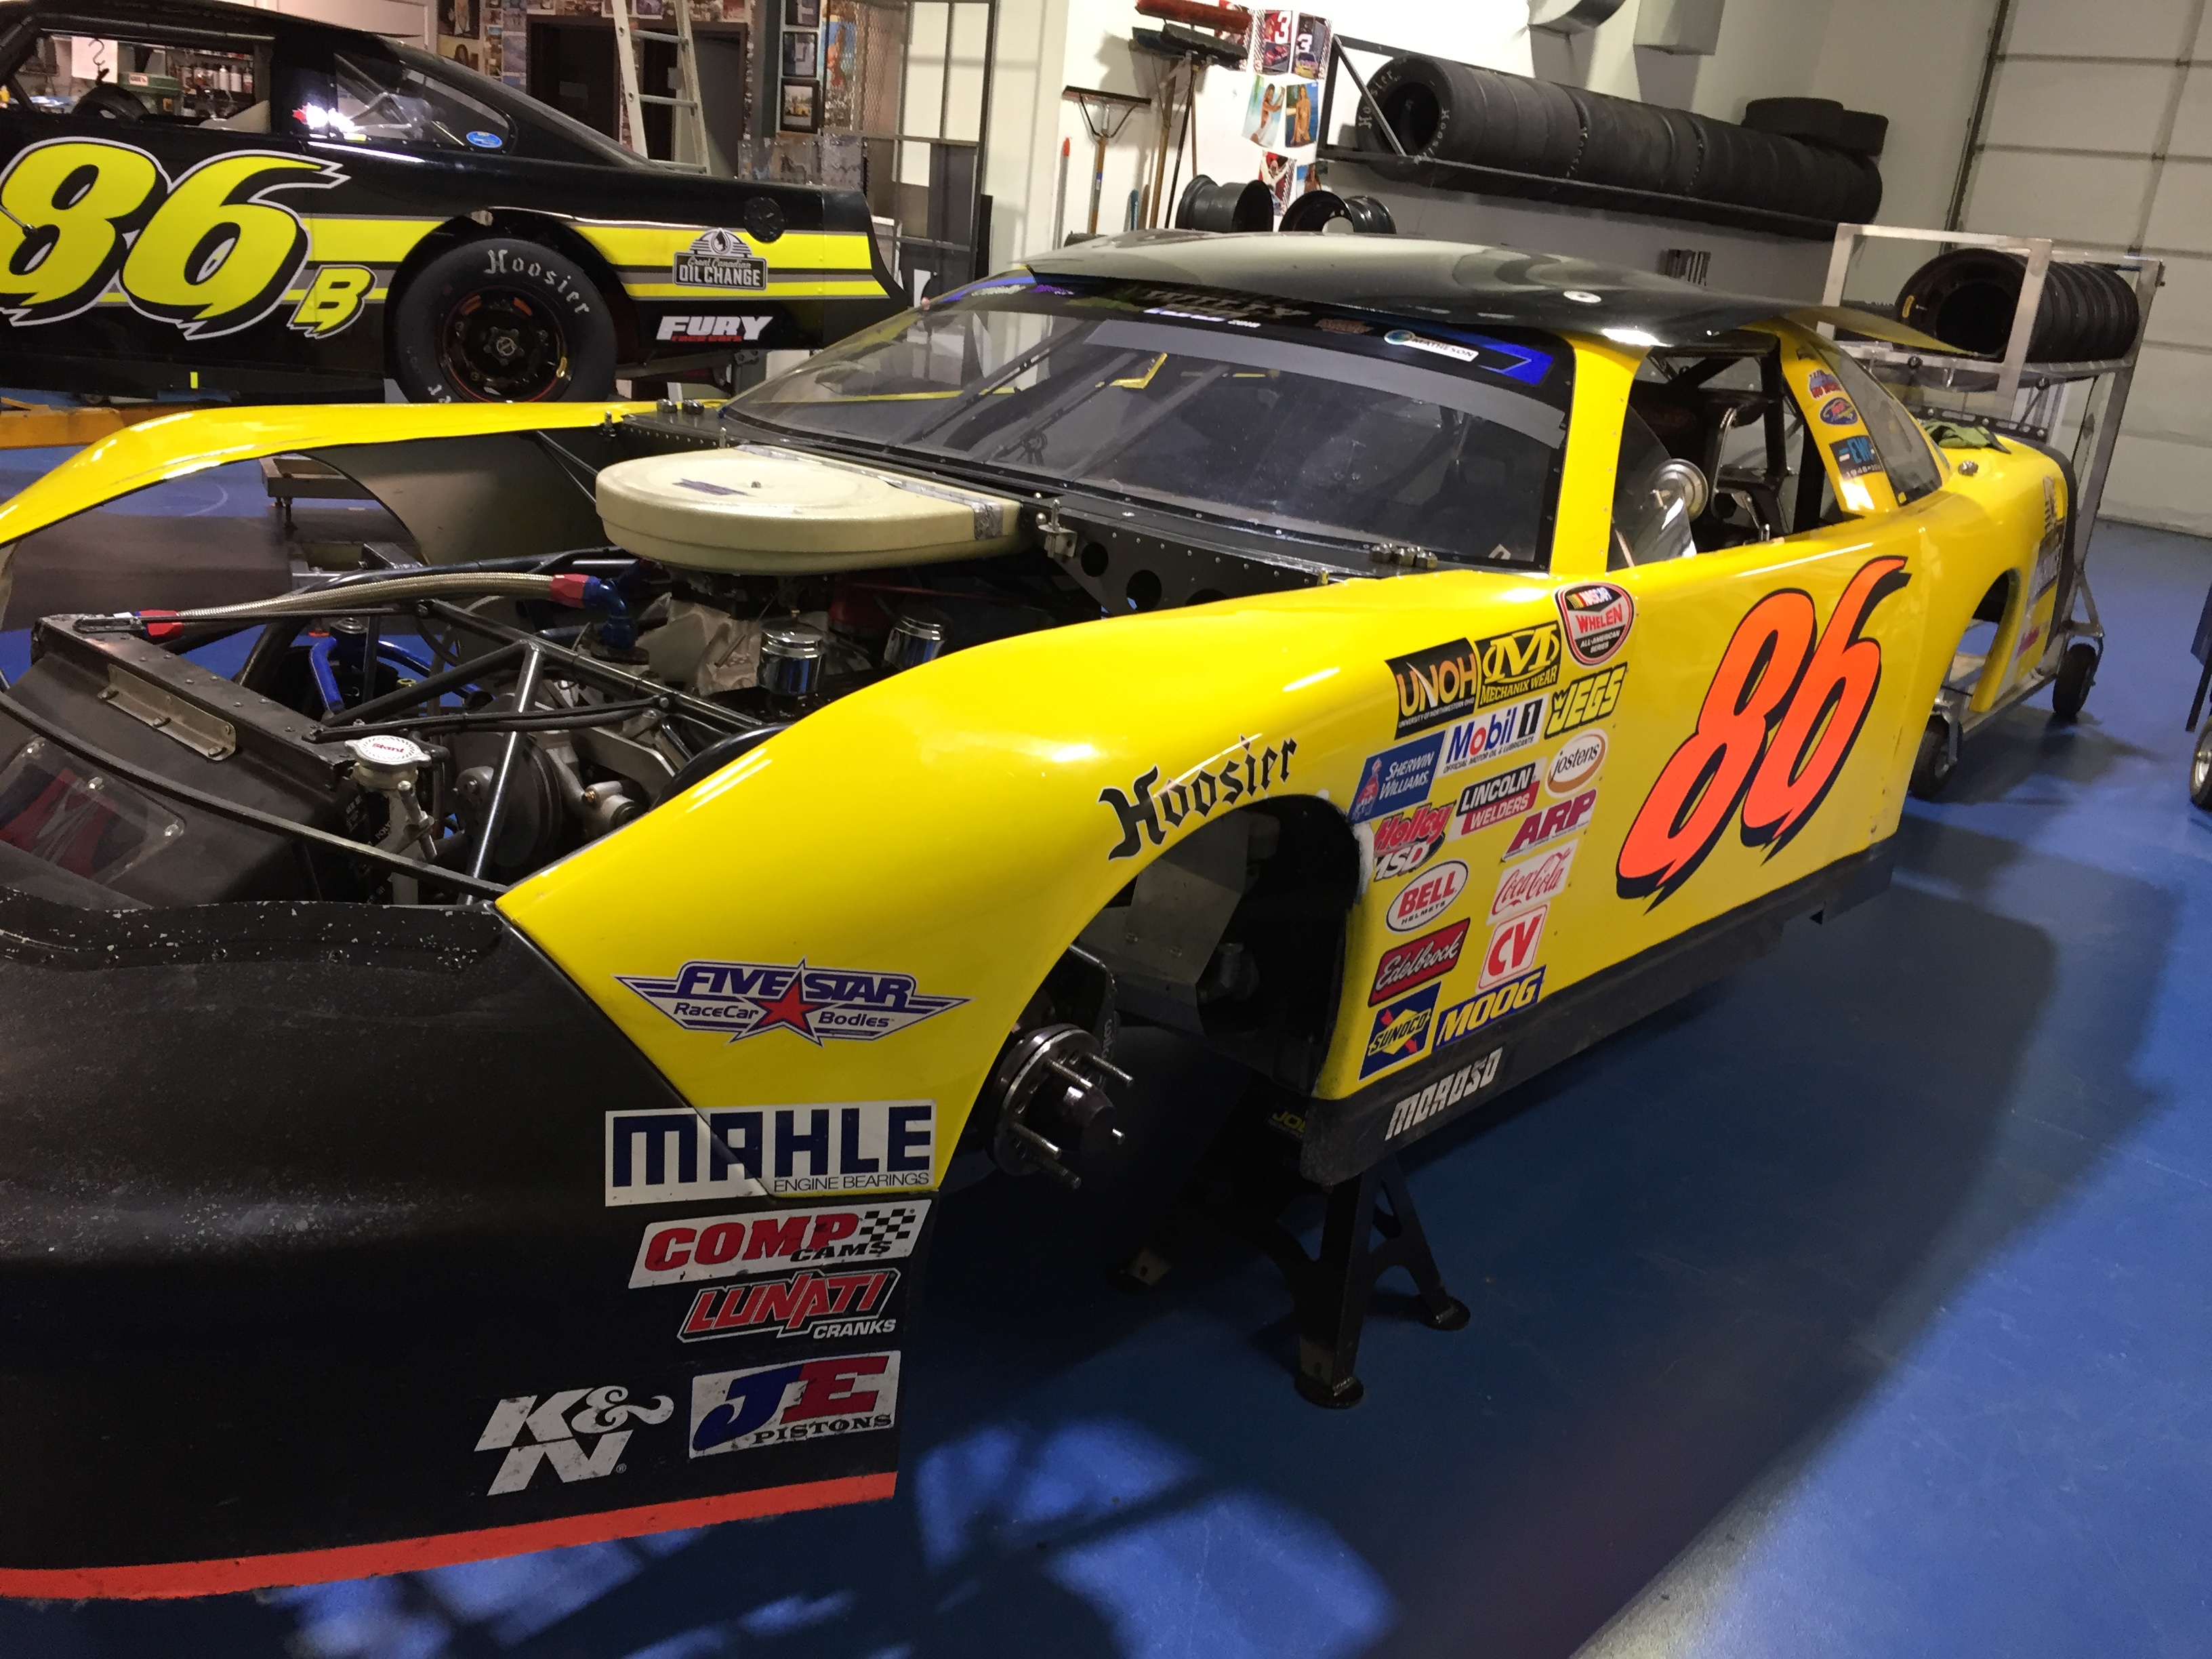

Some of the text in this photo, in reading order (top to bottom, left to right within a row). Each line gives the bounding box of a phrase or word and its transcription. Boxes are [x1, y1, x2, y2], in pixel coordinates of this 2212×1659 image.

[1275, 11, 1291, 43] 3
[1358, 70, 1393, 129] Hosier
[0, 137, 377, 340] 86 B
[484, 249, 590, 314] Hoosier
[679, 264, 761, 287] OIL CHANGE
[655, 316, 773, 340] FURY
[1575, 602, 1623, 634] WHELEN
[1580, 630, 1621, 649] ALL-AMERICAN
[1397, 653, 1477, 717] UNOH
[1479, 665, 1558, 705] MECHANIX WEAR
[1544, 661, 1629, 739] JEGS
[1446, 706, 1518, 764] Mobil
[1616, 556, 1912, 916] 86
[1378, 770, 1430, 800] WILLIAMS
[1385, 750, 1435, 781] SHERWIN
[1547, 743, 1600, 786] jostens
[1097, 733, 1298, 861] Hoosier
[1461, 766, 1534, 813] LINCOLN
[1470, 793, 1530, 830] WELDERS
[1373, 802, 1455, 852] Holley
[1505, 789, 1597, 855] ARP
[1397, 871, 1457, 919] BELL
[1401, 901, 1446, 926] HELMETS
[1375, 930, 1465, 991] Edelbrock
[1488, 914, 1542, 977] CV
[673, 1000, 759, 1021] RaceCar
[677, 966, 915, 1008] FIVE STAR
[1436, 970, 1542, 1046] MOOG
[1370, 1010, 1431, 1053] SUNOCO
[1384, 1046, 1503, 1142] MOROSO
[612, 1105, 933, 1187] MAHLE
[774, 1172, 930, 1193] ENGINE BEARINGS
[644, 1212, 861, 1272] COMP
[789, 1240, 893, 1263] CAMS
[684, 1273, 888, 1334] LUNATI
[813, 1318, 897, 1339] CRANKS
[693, 1355, 890, 1451] JE
[474, 1385, 674, 1496] K&N
[753, 1414, 893, 1445] PISTONS
